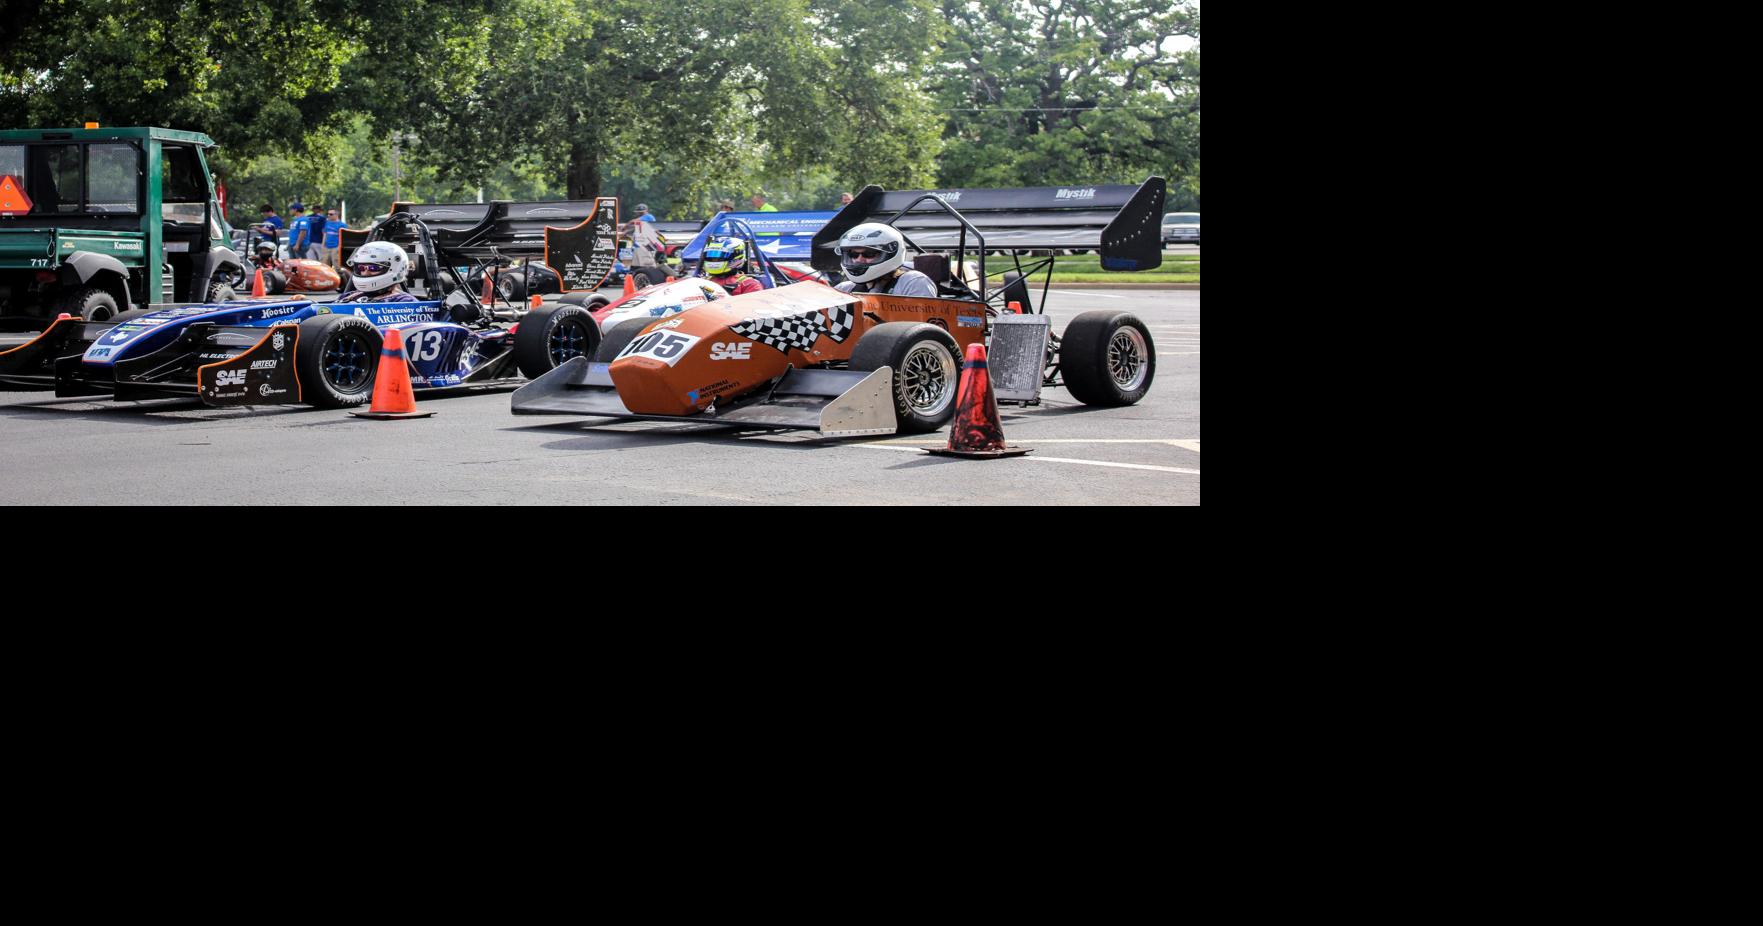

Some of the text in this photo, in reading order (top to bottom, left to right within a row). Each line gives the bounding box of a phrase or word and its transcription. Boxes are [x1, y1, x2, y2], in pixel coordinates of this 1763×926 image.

[1055, 188, 1096, 199] Mystik
[114, 241, 142, 250] Kawasaki
[30, 258, 48, 267] 717
[261, 306, 295, 319] Hoosier
[381, 307, 414, 315] University
[880, 301, 937, 314] University
[940, 302, 952, 315] of
[377, 313, 434, 324] ARLINGTON
[338, 319, 373, 333] Hoosier
[411, 330, 442, 361] 13
[621, 331, 690, 358] 105
[709, 342, 753, 360] SAE
[250, 360, 278, 369] AIRTECH
[215, 369, 247, 386] SAE
